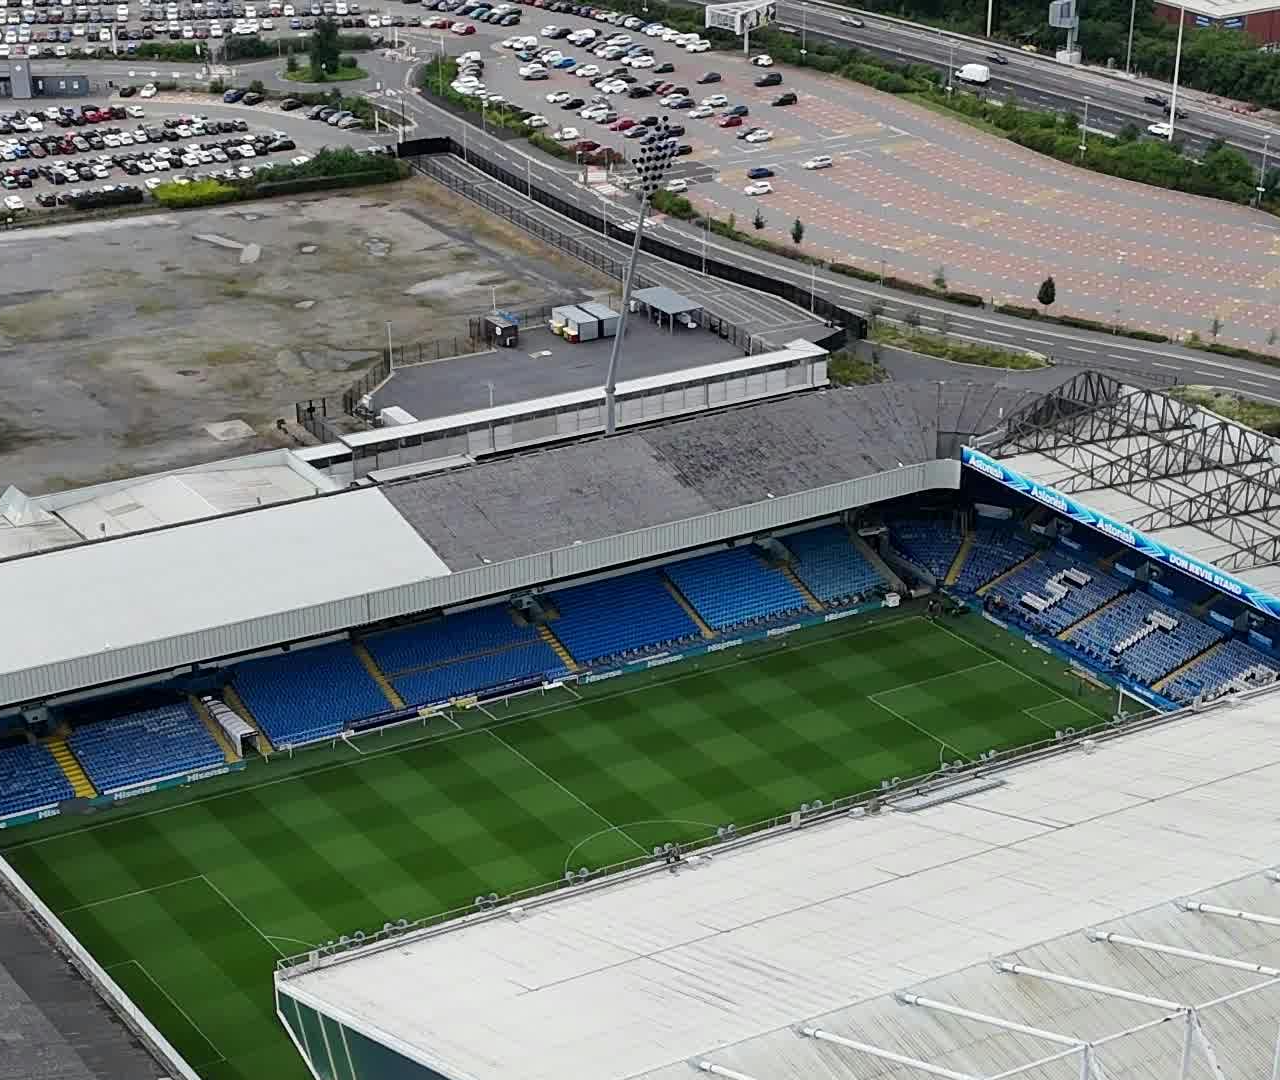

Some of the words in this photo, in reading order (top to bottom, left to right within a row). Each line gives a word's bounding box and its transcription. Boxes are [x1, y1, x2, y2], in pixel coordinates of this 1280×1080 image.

[1031, 486, 1068, 511] Astonish
[1097, 518, 1136, 545] Astonish
[1169, 554, 1188, 569] DON
[1188, 562, 1213, 582] REVIE
[1213, 574, 1242, 595] STAND
[187, 767, 230, 783] Hisense
[113, 784, 158, 800] Hisense
